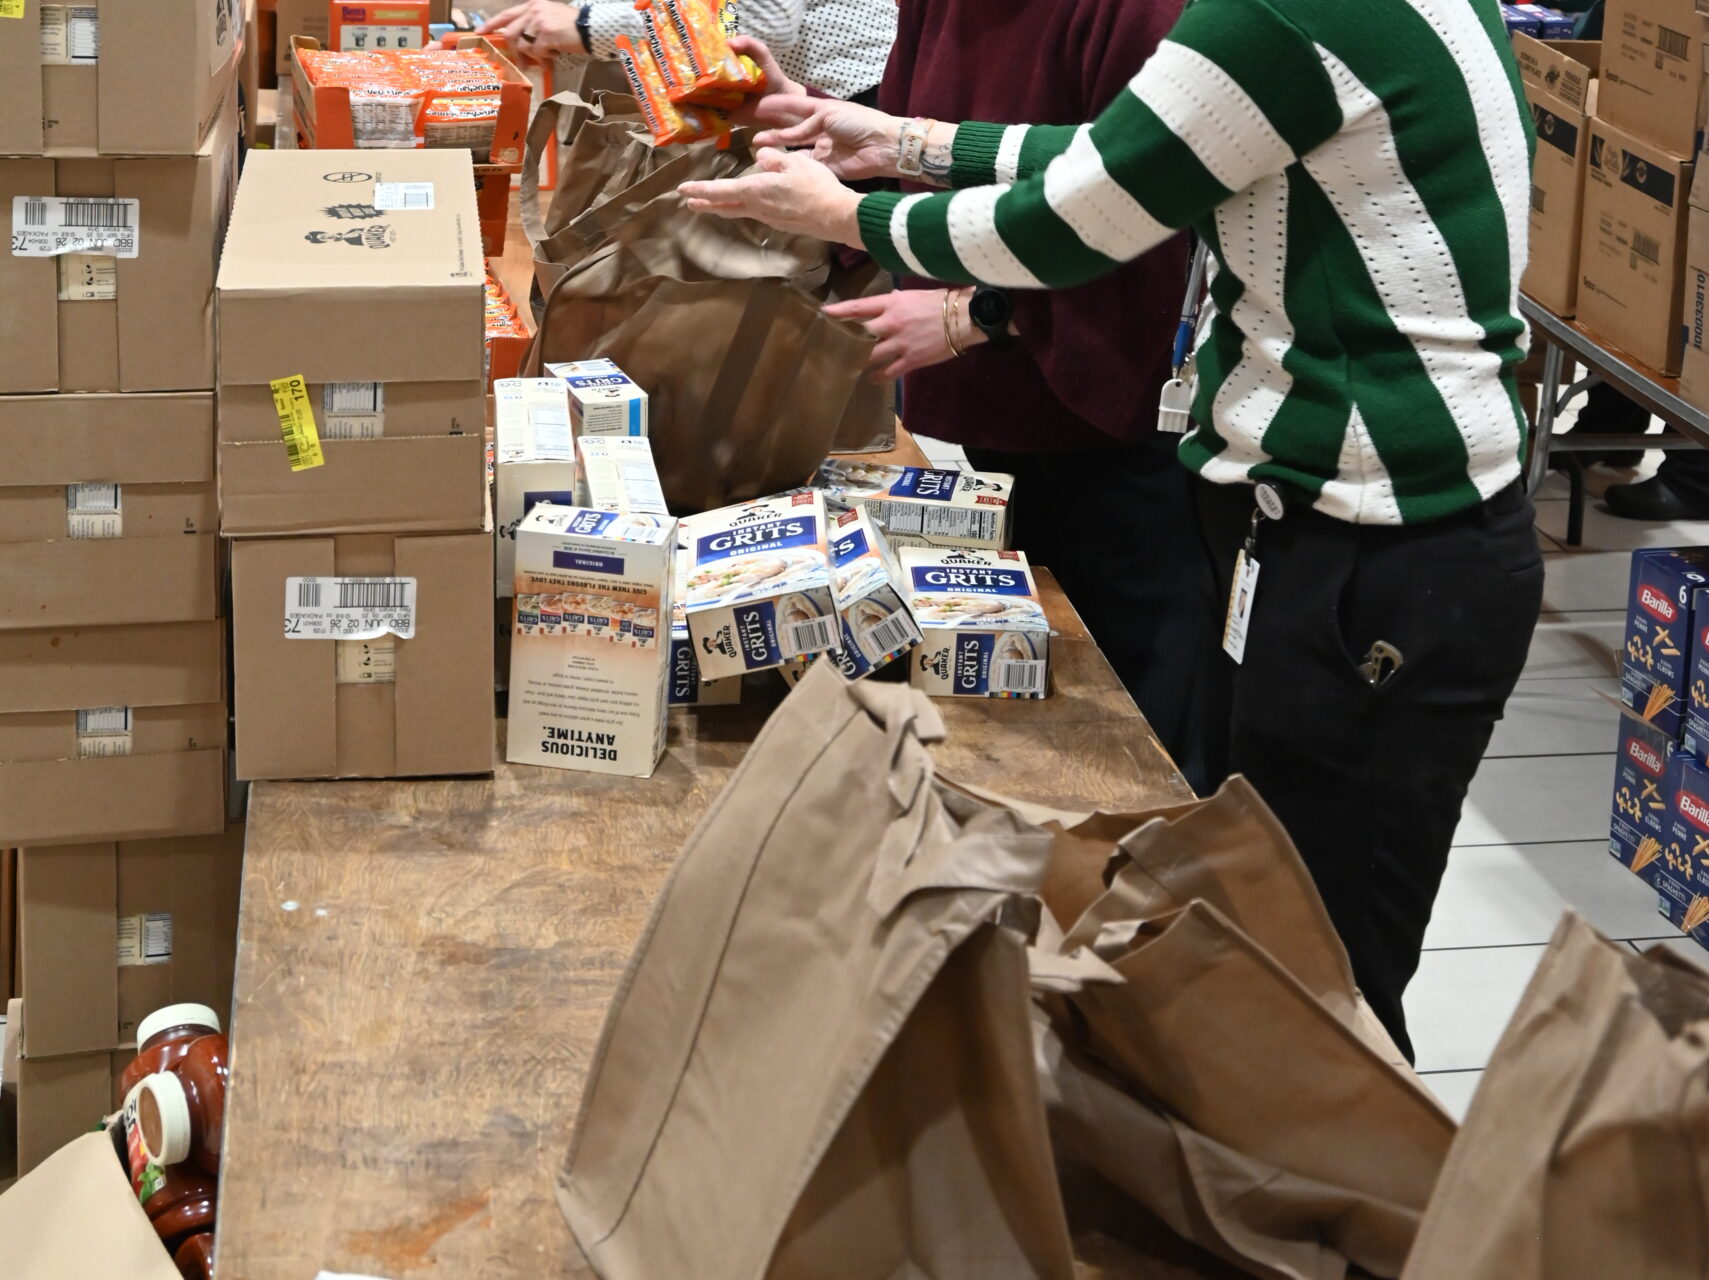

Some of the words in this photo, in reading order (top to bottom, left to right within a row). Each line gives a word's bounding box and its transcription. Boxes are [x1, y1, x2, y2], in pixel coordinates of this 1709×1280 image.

[667, 0, 690, 45] Maruchan
[644, 14, 665, 60] Maruchan
[624, 57, 647, 102] Maruchan
[55, 238, 66, 246] 26
[113, 239, 133, 247] BBD
[365, 224, 391, 249] QUAKER
[290, 380, 304, 401] 170
[729, 513, 782, 527] QUAKER
[733, 522, 782, 536] INSTANT
[709, 522, 804, 551] GRITS
[730, 542, 783, 556] ORIGINAL
[548, 578, 565, 586] THEY
[567, 581, 596, 589] FLAVORS
[925, 571, 1015, 587] GRITS
[1642, 589, 1673, 618] Barilla
[1679, 585, 1687, 604] 6
[347, 620, 359, 628] 02
[365, 619, 383, 628] JUN
[390, 619, 410, 628] BBD
[767, 619, 776, 647] ORIGINAL
[726, 625, 737, 658] QUAKER
[740, 625, 750, 651] INSTANT
[744, 612, 768, 661] GRITS
[675, 646, 692, 697] GRITS
[941, 647, 950, 680] QUAKER
[962, 640, 979, 689] GRITS
[1657, 663, 1675, 679] ELBOWS
[543, 726, 616, 746] ANYTIME.
[541, 740, 618, 761] DELICIOUS
[1630, 742, 1660, 773] Barilla
[1644, 815, 1662, 833] ELBOWS
[1672, 825, 1687, 841] PENNE
[1662, 880, 1686, 902] SPAGHETTI
